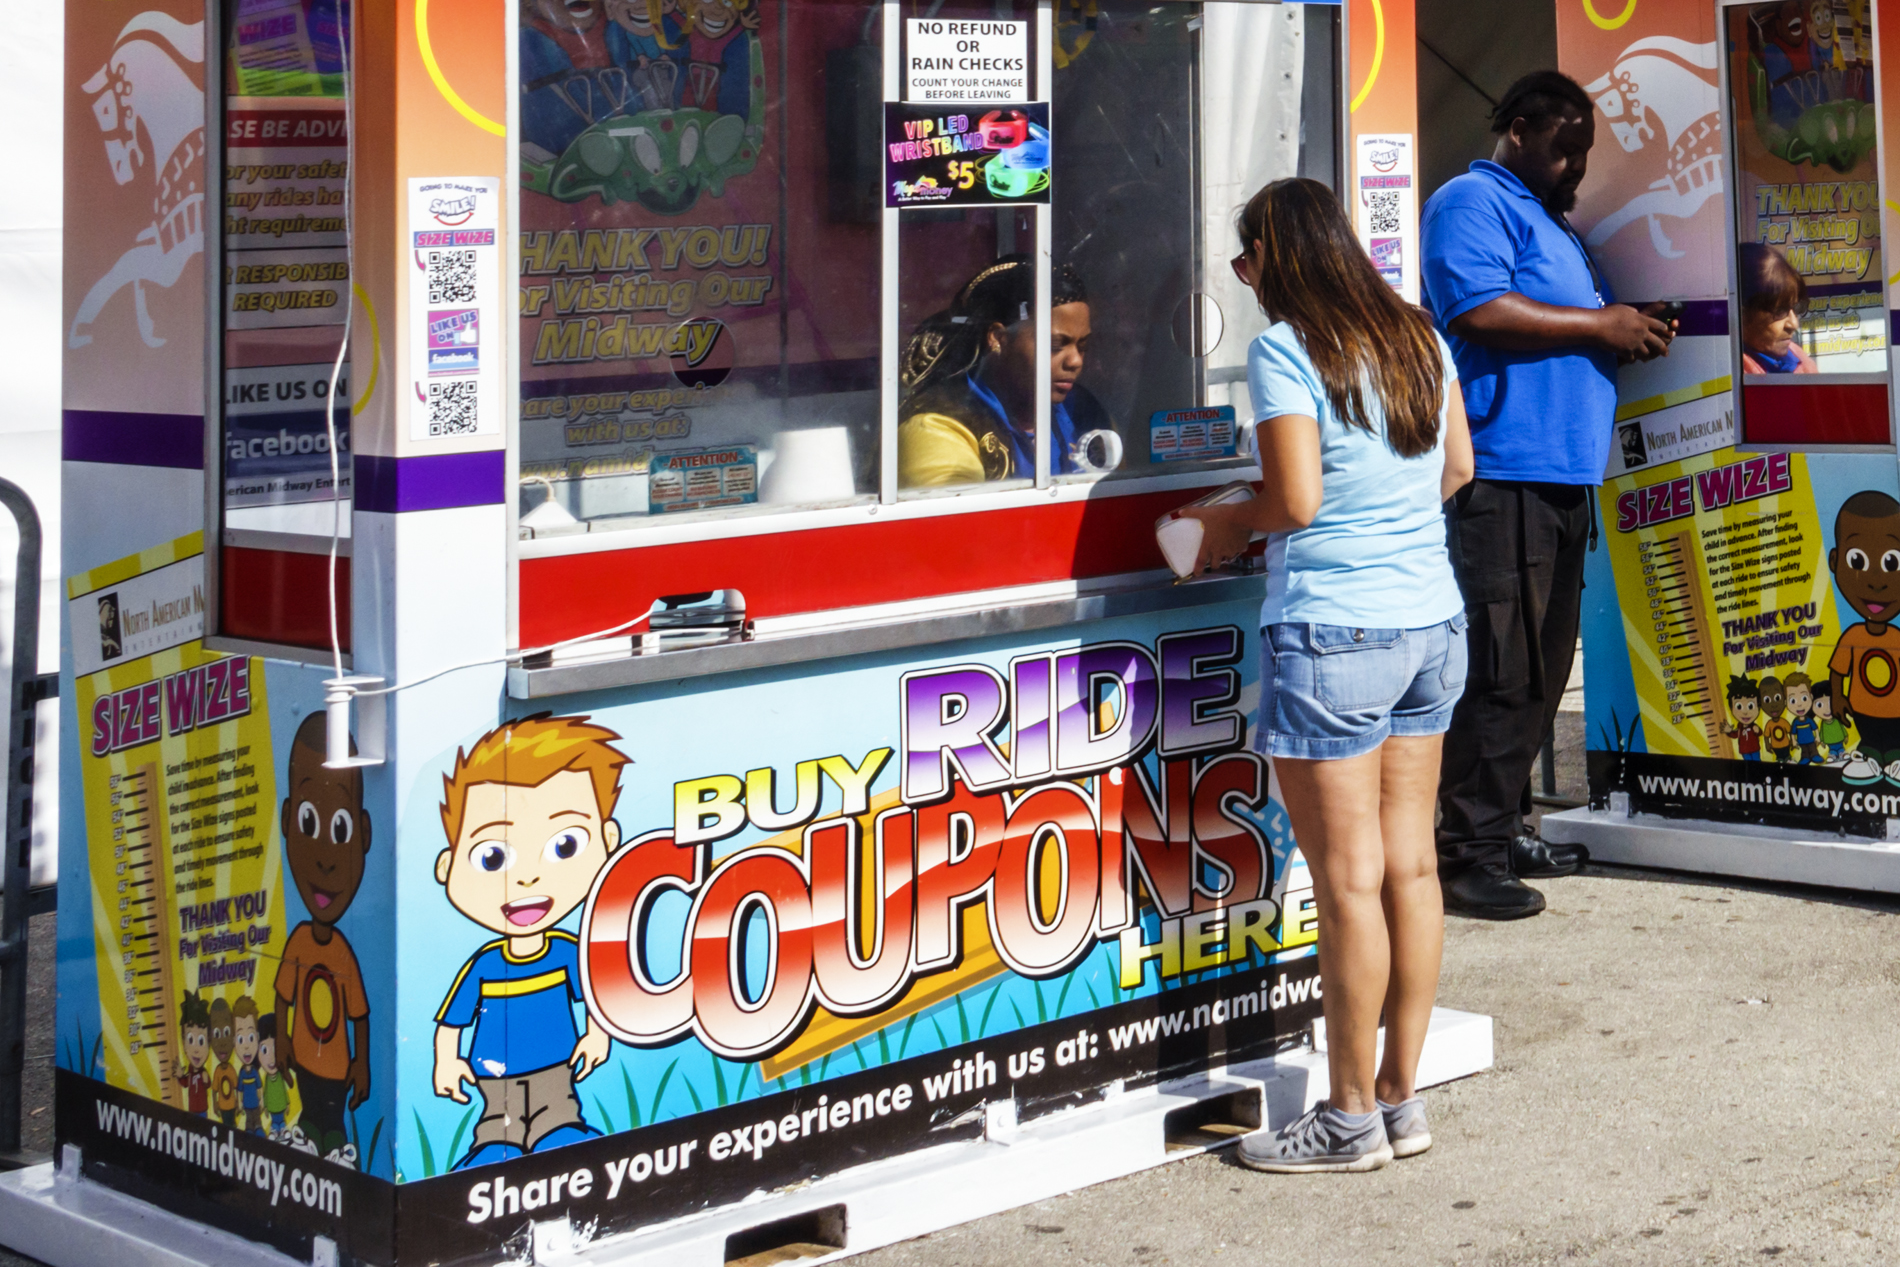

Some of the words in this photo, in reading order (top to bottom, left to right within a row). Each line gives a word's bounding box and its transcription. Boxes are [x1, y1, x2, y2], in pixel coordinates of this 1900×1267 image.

[918, 22, 943, 34] NO
[949, 22, 1016, 35] REFUND
[957, 40, 980, 52] OR
[912, 58, 953, 70] RAIN
[959, 58, 1023, 70] CHECKS
[912, 78, 948, 87] COUNT
[951, 78, 979, 87] YOUR
[982, 78, 1023, 87] CHANGE
[925, 90, 965, 99] BEFORE
[968, 90, 1011, 99] LEAVING
[889, 132, 984, 162] WRISTBAND
[904, 119, 934, 140] VIP
[938, 114, 969, 135] LED
[947, 160, 975, 189] $5
[1616, 476, 1694, 532] SIZE
[1696, 453, 1791, 513] WIZE
[92, 679, 161, 754] SIZE
[164, 654, 250, 737] WIZE
[898, 624, 1247, 805] RIDE
[673, 747, 894, 845] BUY
[579, 749, 1274, 1060] COUPONS
[1119, 886, 1318, 990] HERE
[466, 1168, 594, 1223] Share
[604, 1139, 699, 1200] your
[708, 1081, 914, 1164] experience
[922, 1047, 998, 1104] with
[1007, 1039, 1046, 1080] us
[1056, 1023, 1099, 1065] at:
[96, 1098, 343, 1218] www.namidway.com
